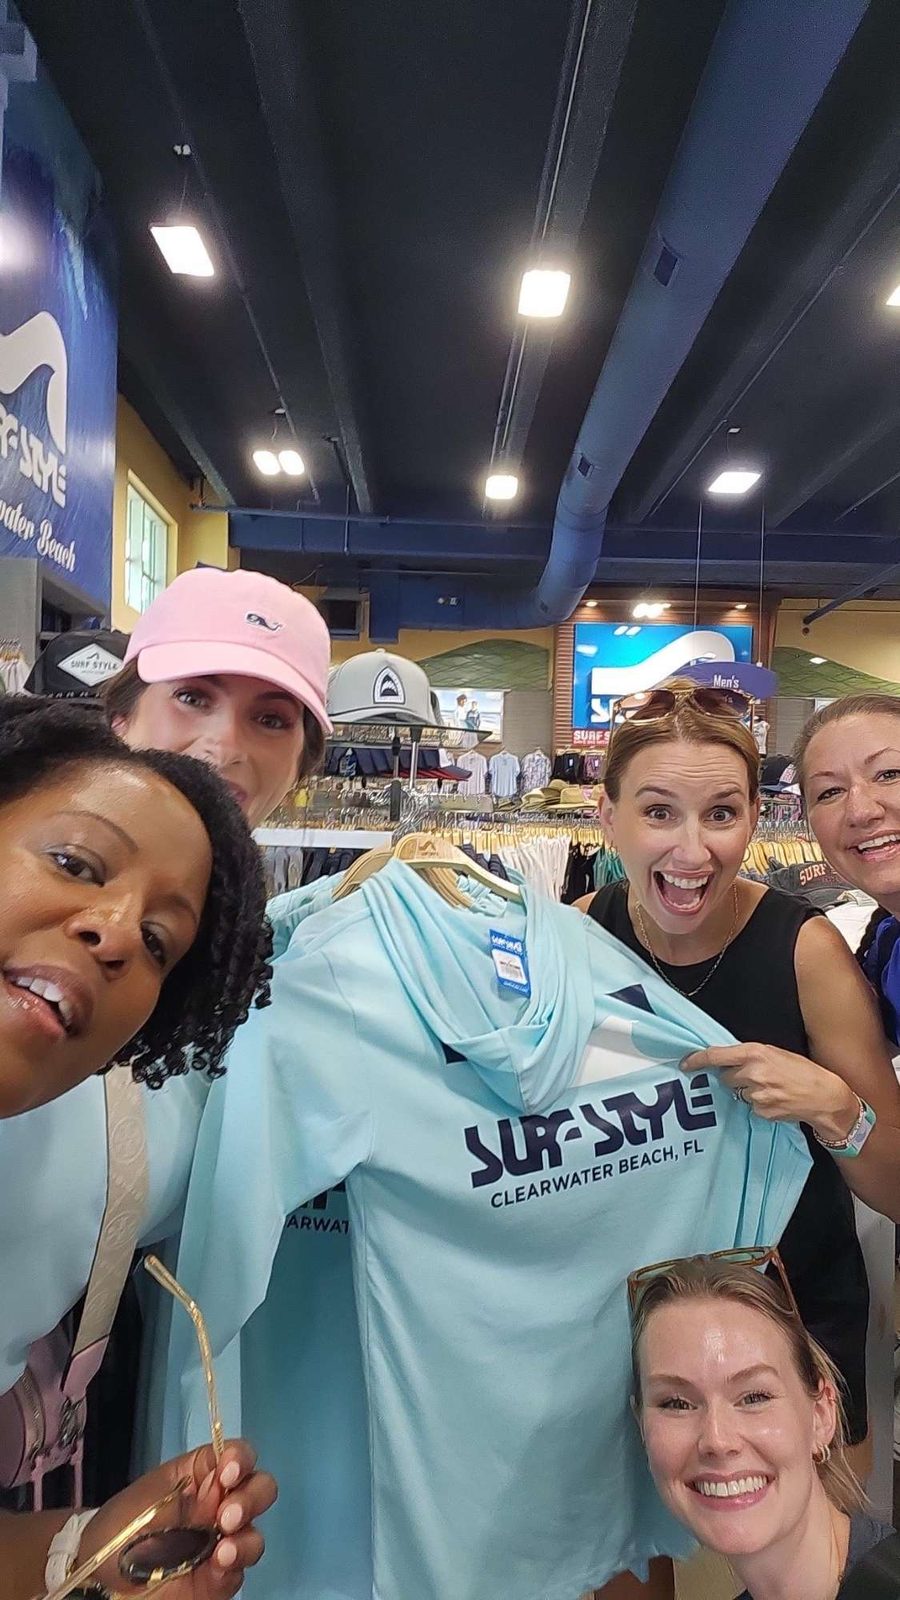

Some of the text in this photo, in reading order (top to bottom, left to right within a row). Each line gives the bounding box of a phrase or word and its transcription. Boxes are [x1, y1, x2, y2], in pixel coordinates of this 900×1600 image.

[37, 518, 76, 573] Beach
[713, 674, 740, 689] Men's
[573, 730, 603, 741] SURF
[799, 863, 828, 886] SURF
[490, 1139, 705, 1209] CLEARWATER BEACH, FL
